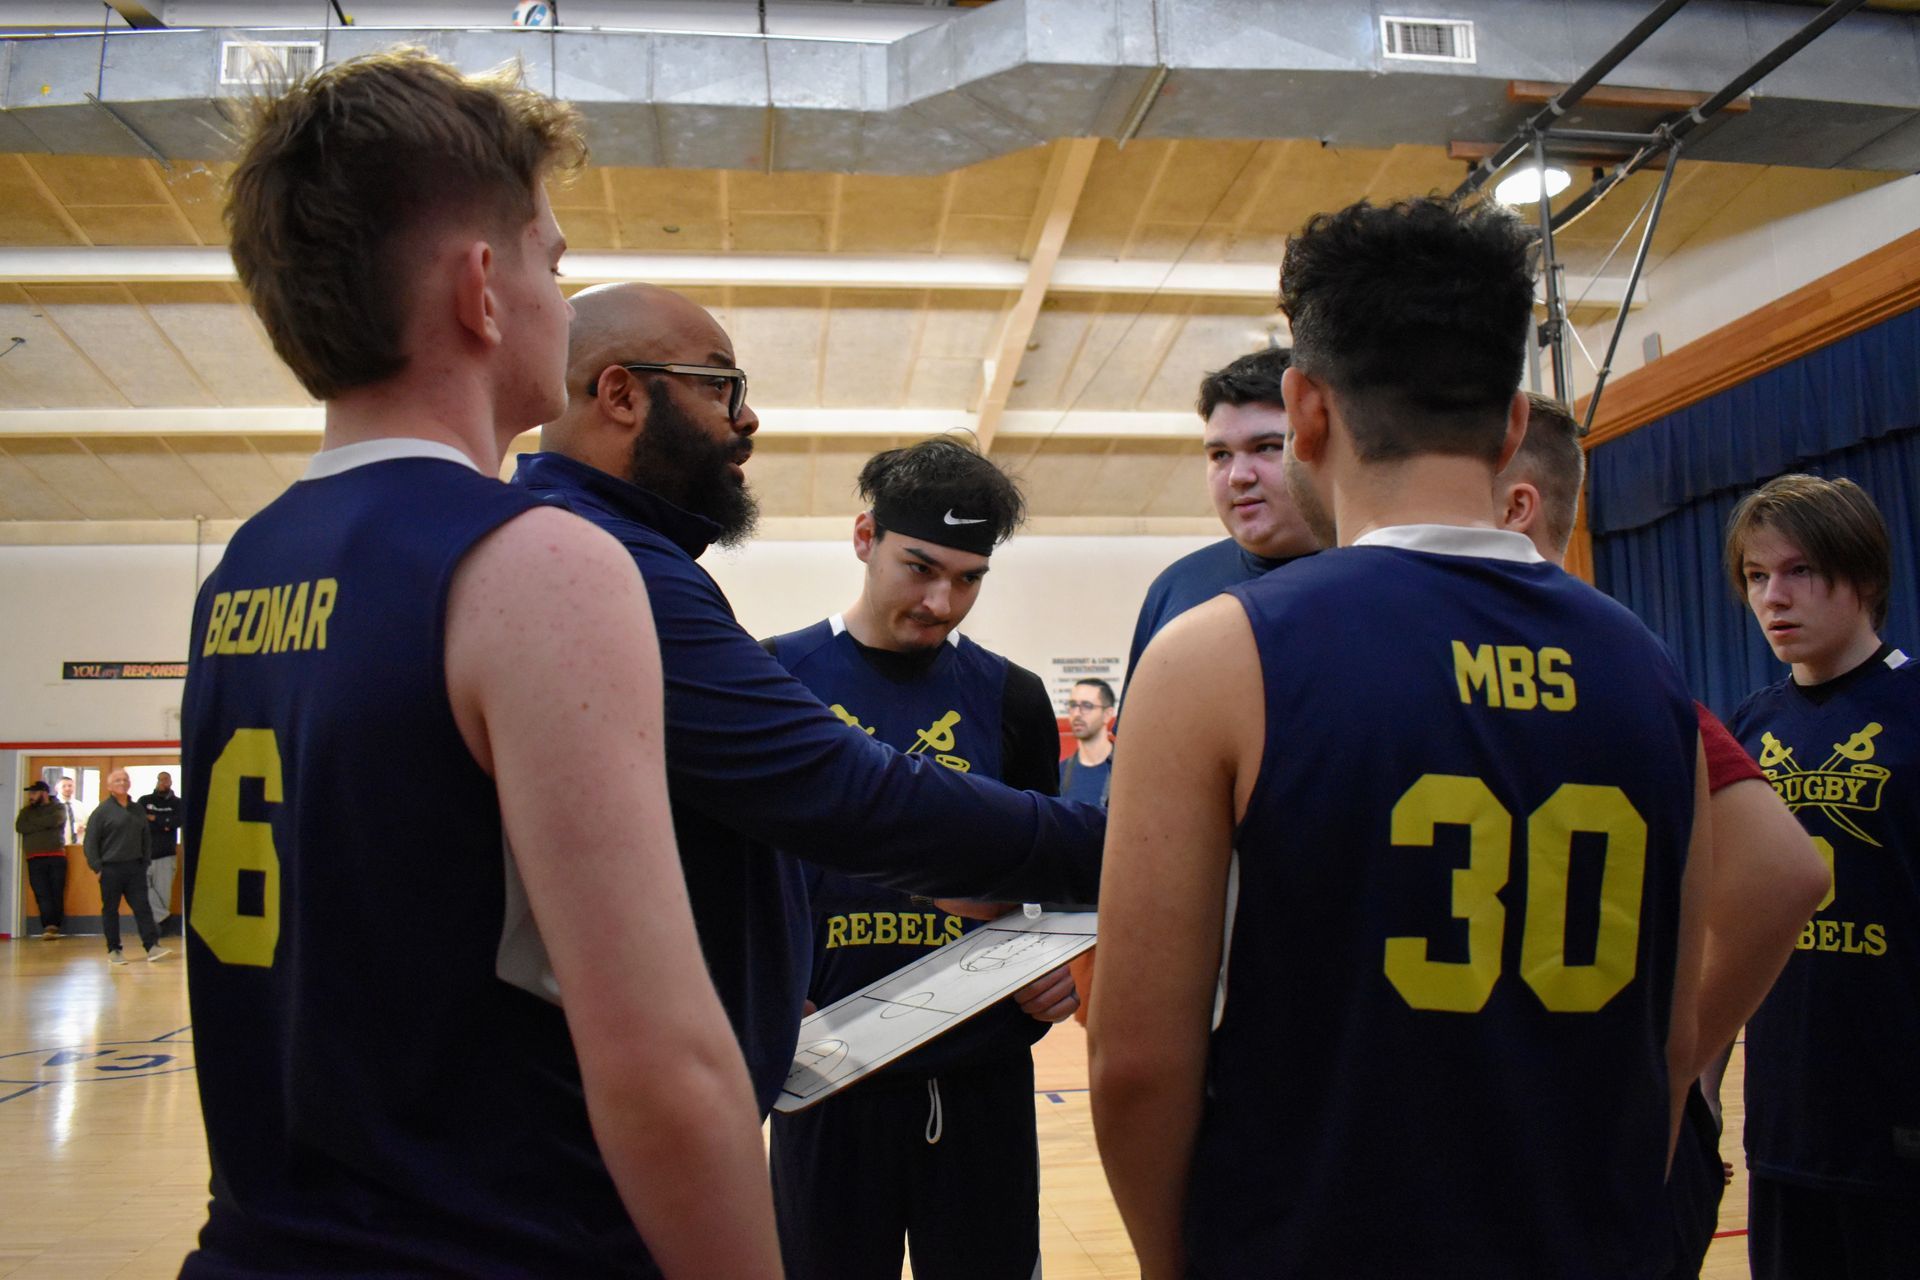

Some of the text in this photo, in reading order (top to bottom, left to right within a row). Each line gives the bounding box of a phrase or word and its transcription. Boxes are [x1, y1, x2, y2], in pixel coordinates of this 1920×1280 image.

[203, 577, 338, 657] BEDNAR
[72, 665, 100, 677] YOU
[122, 664, 188, 678] RESPONSIB
[1451, 640, 1577, 712] MBS
[190, 728, 284, 968] 6
[1384, 773, 1647, 1012] 30
[826, 912, 964, 949] REBELS
[1795, 920, 1888, 956] BELS
